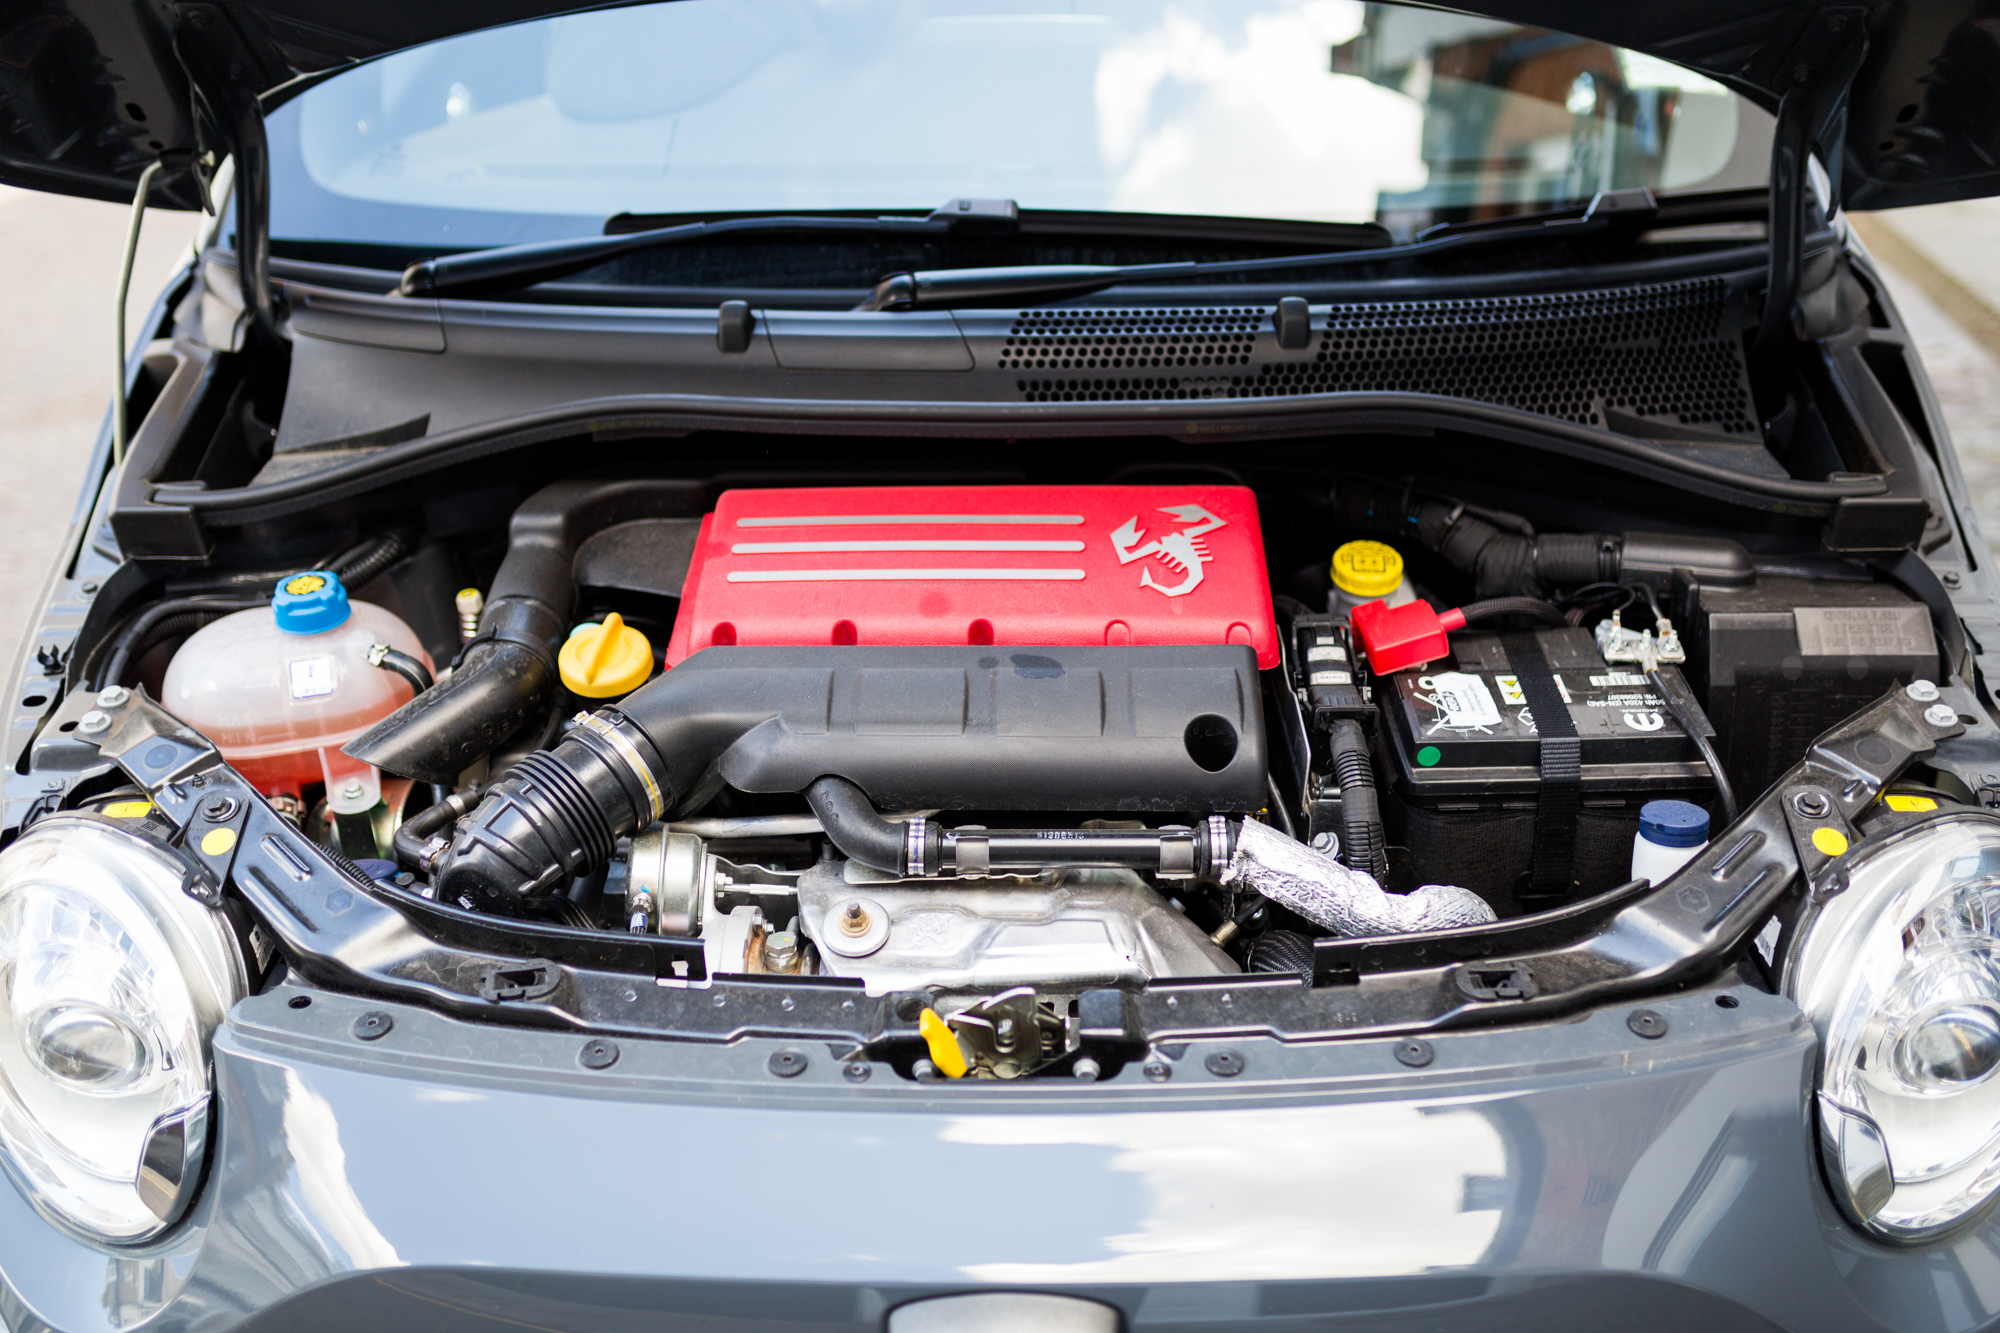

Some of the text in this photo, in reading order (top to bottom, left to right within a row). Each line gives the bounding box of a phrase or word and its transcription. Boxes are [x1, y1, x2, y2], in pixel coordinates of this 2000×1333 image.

[1826, 637, 1913, 648] FUSE AND RELAY BOX
[218, 714, 252, 727] MAX
[221, 732, 256, 744] MIN
